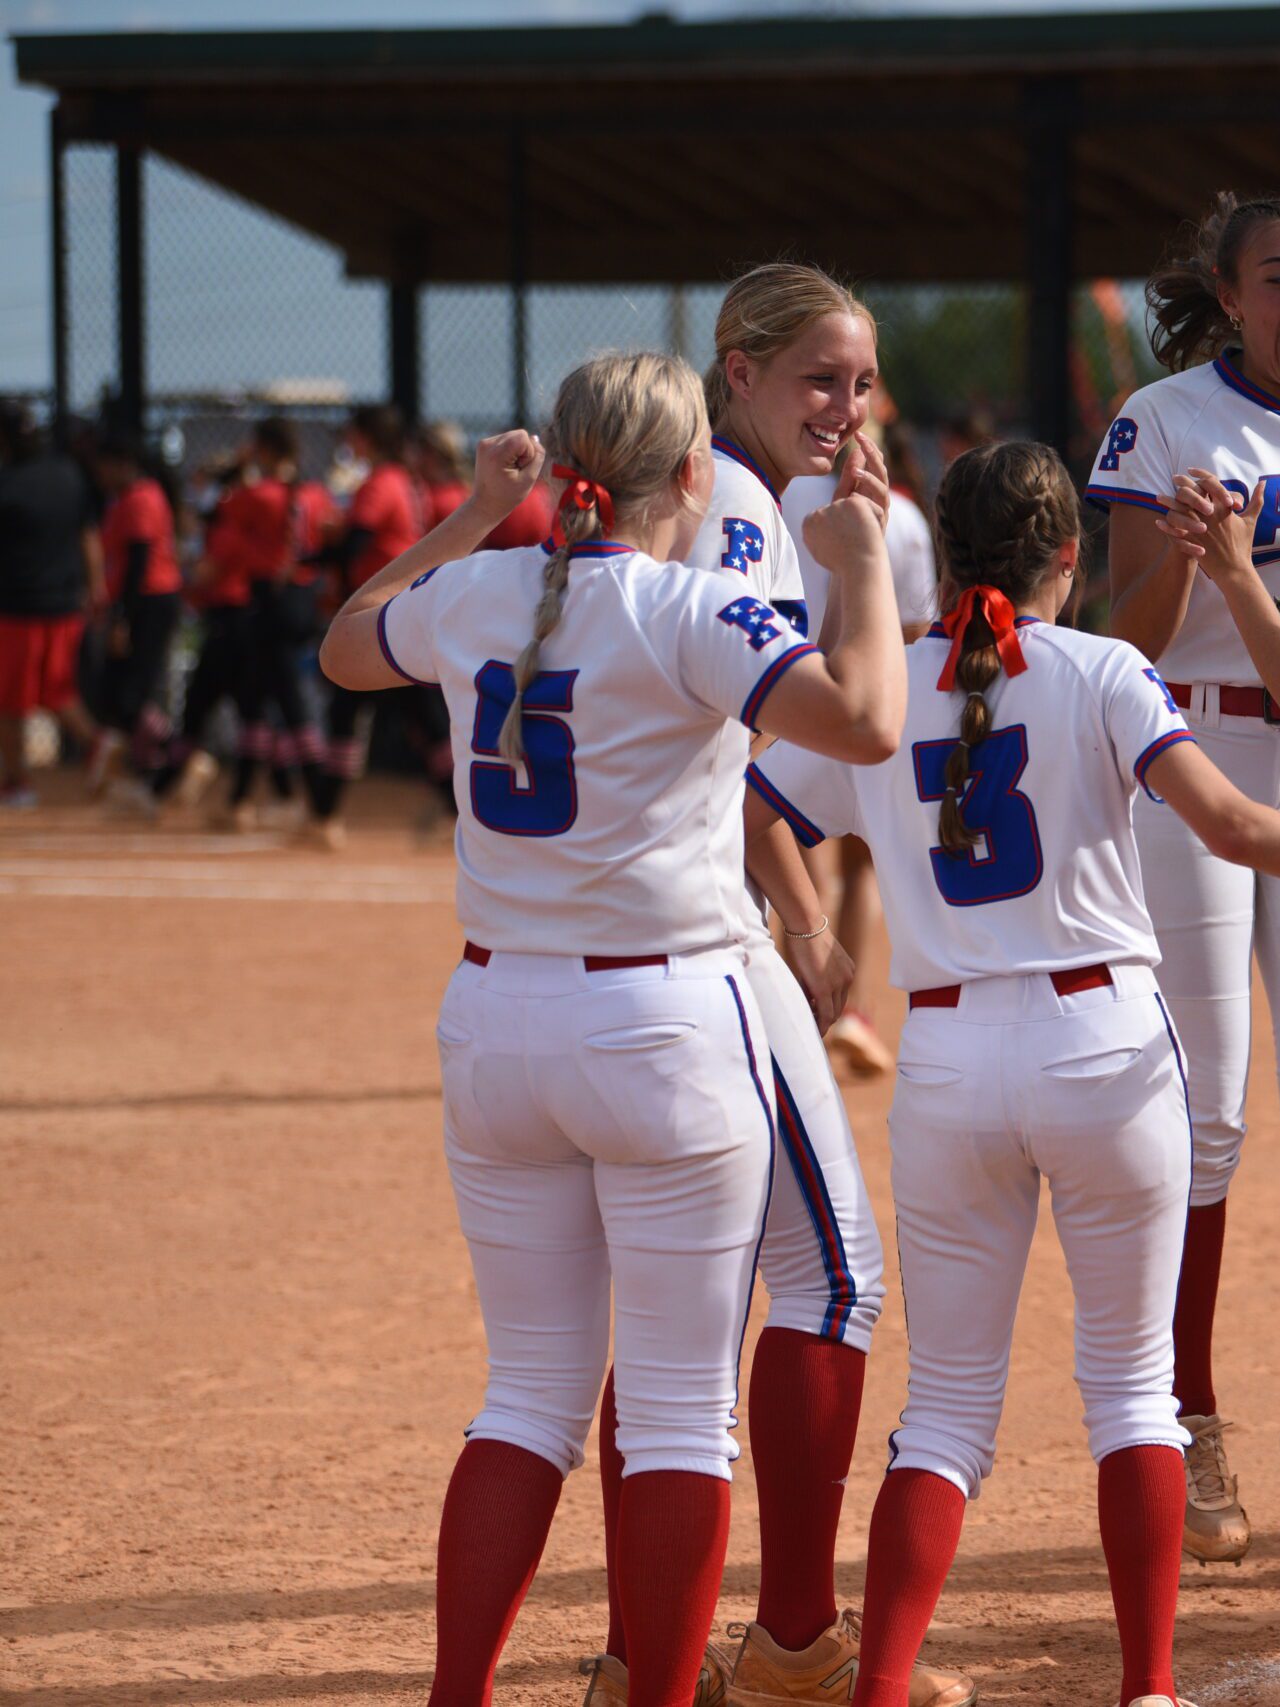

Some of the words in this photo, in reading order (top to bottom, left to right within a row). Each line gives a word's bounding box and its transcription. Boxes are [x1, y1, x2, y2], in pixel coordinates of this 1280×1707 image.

[1098, 417, 1140, 472] P
[721, 516, 765, 577] P
[470, 658, 580, 838] 5
[911, 723, 1044, 908] 3
